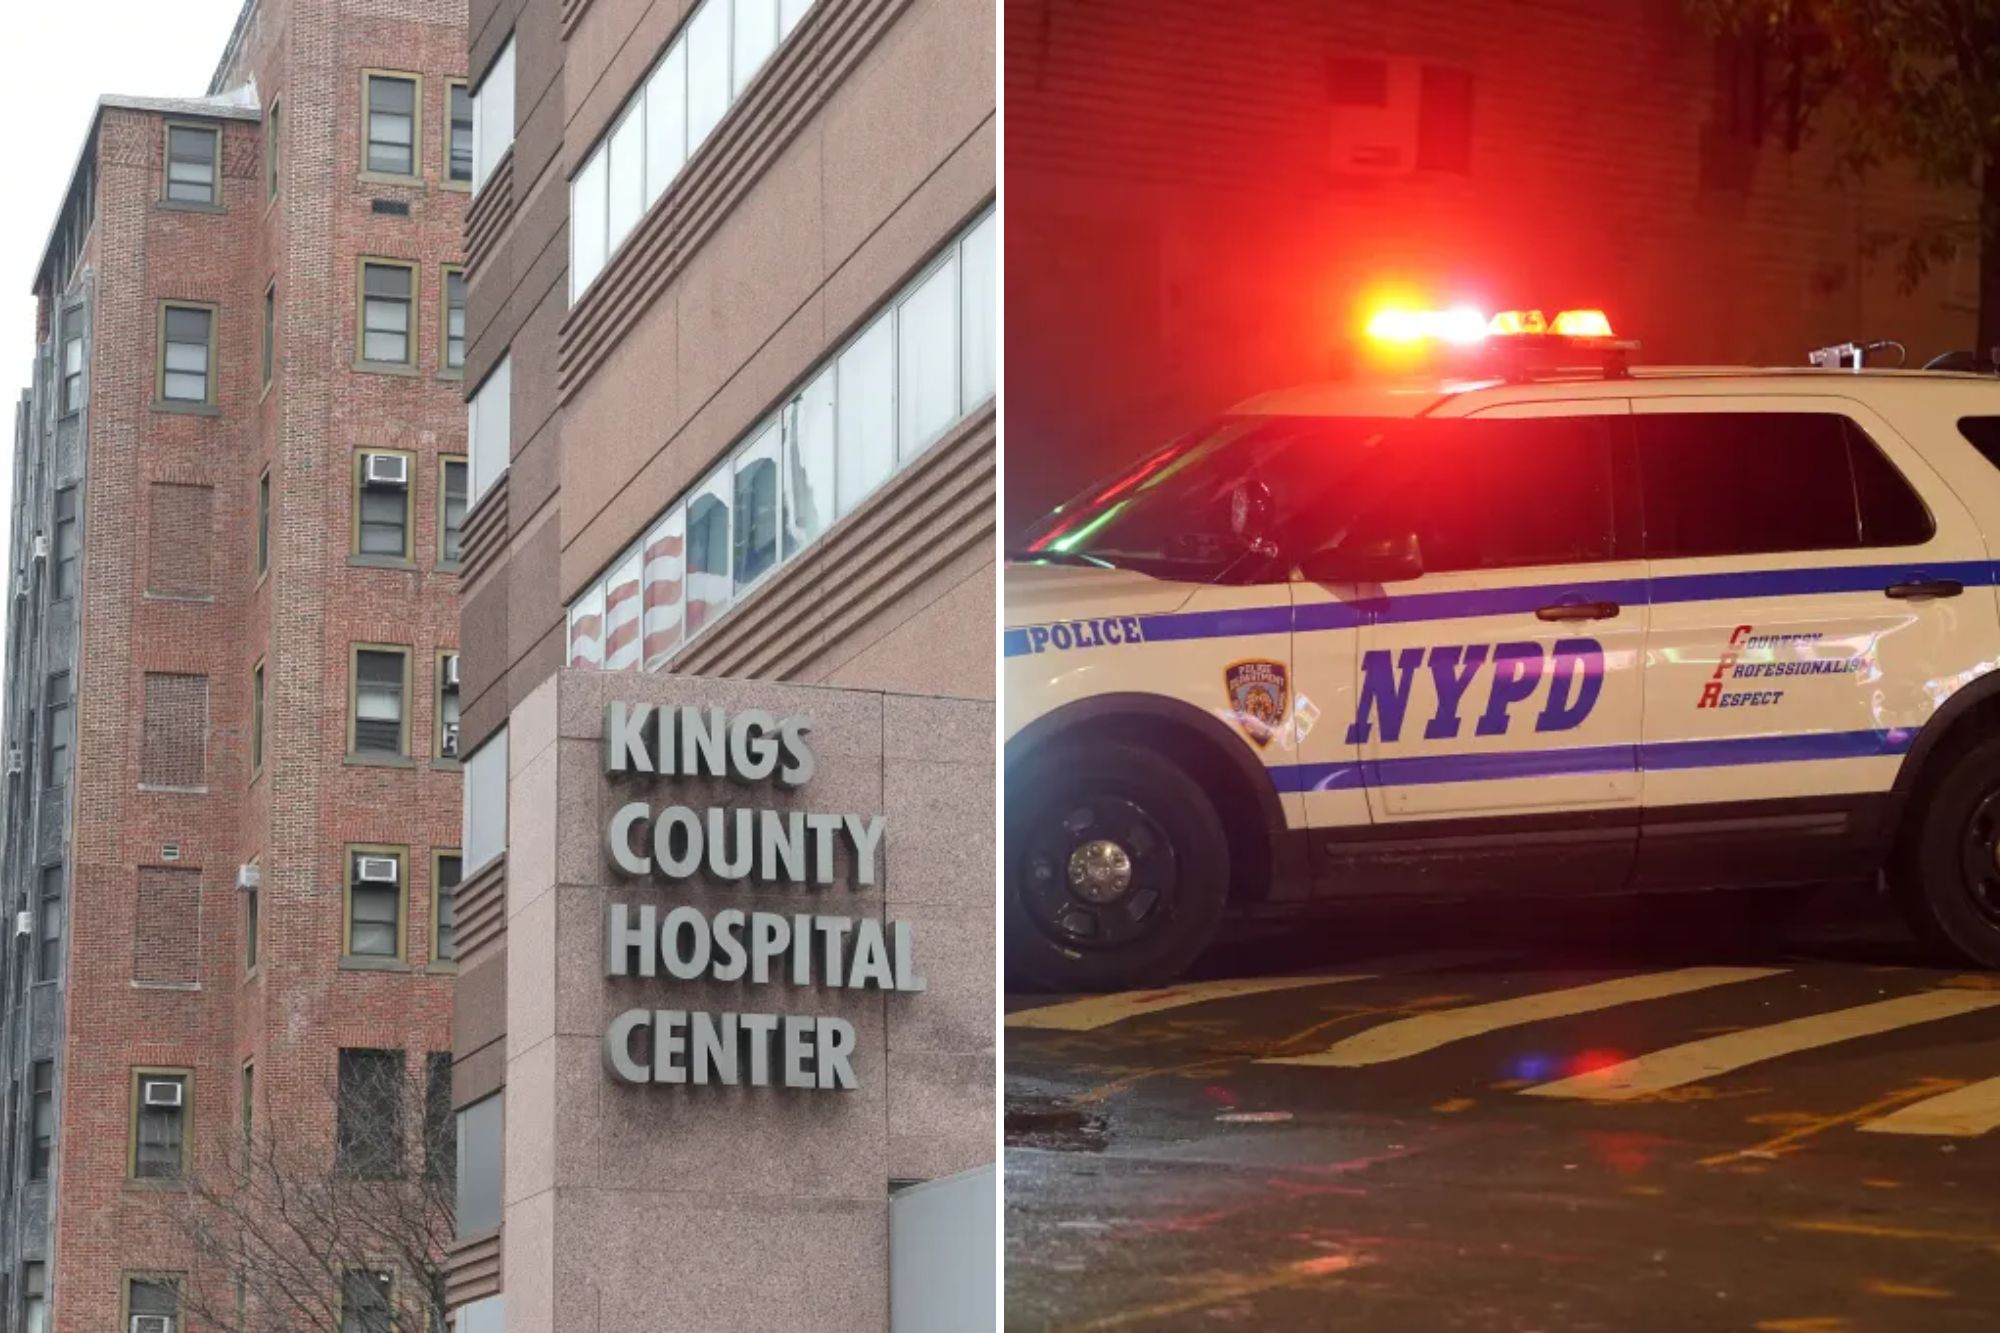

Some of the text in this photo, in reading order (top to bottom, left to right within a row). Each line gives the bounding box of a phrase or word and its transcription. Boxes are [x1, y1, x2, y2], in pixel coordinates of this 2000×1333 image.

[1030, 616, 1141, 653] POLICE
[1345, 638, 1605, 745] NYPD
[1697, 682, 1784, 709] RESPECT
[607, 701, 815, 786] KINGS
[608, 802, 887, 885] COUNTY
[607, 903, 928, 992] HOSPITAL
[606, 1008, 860, 1090] CENTER
